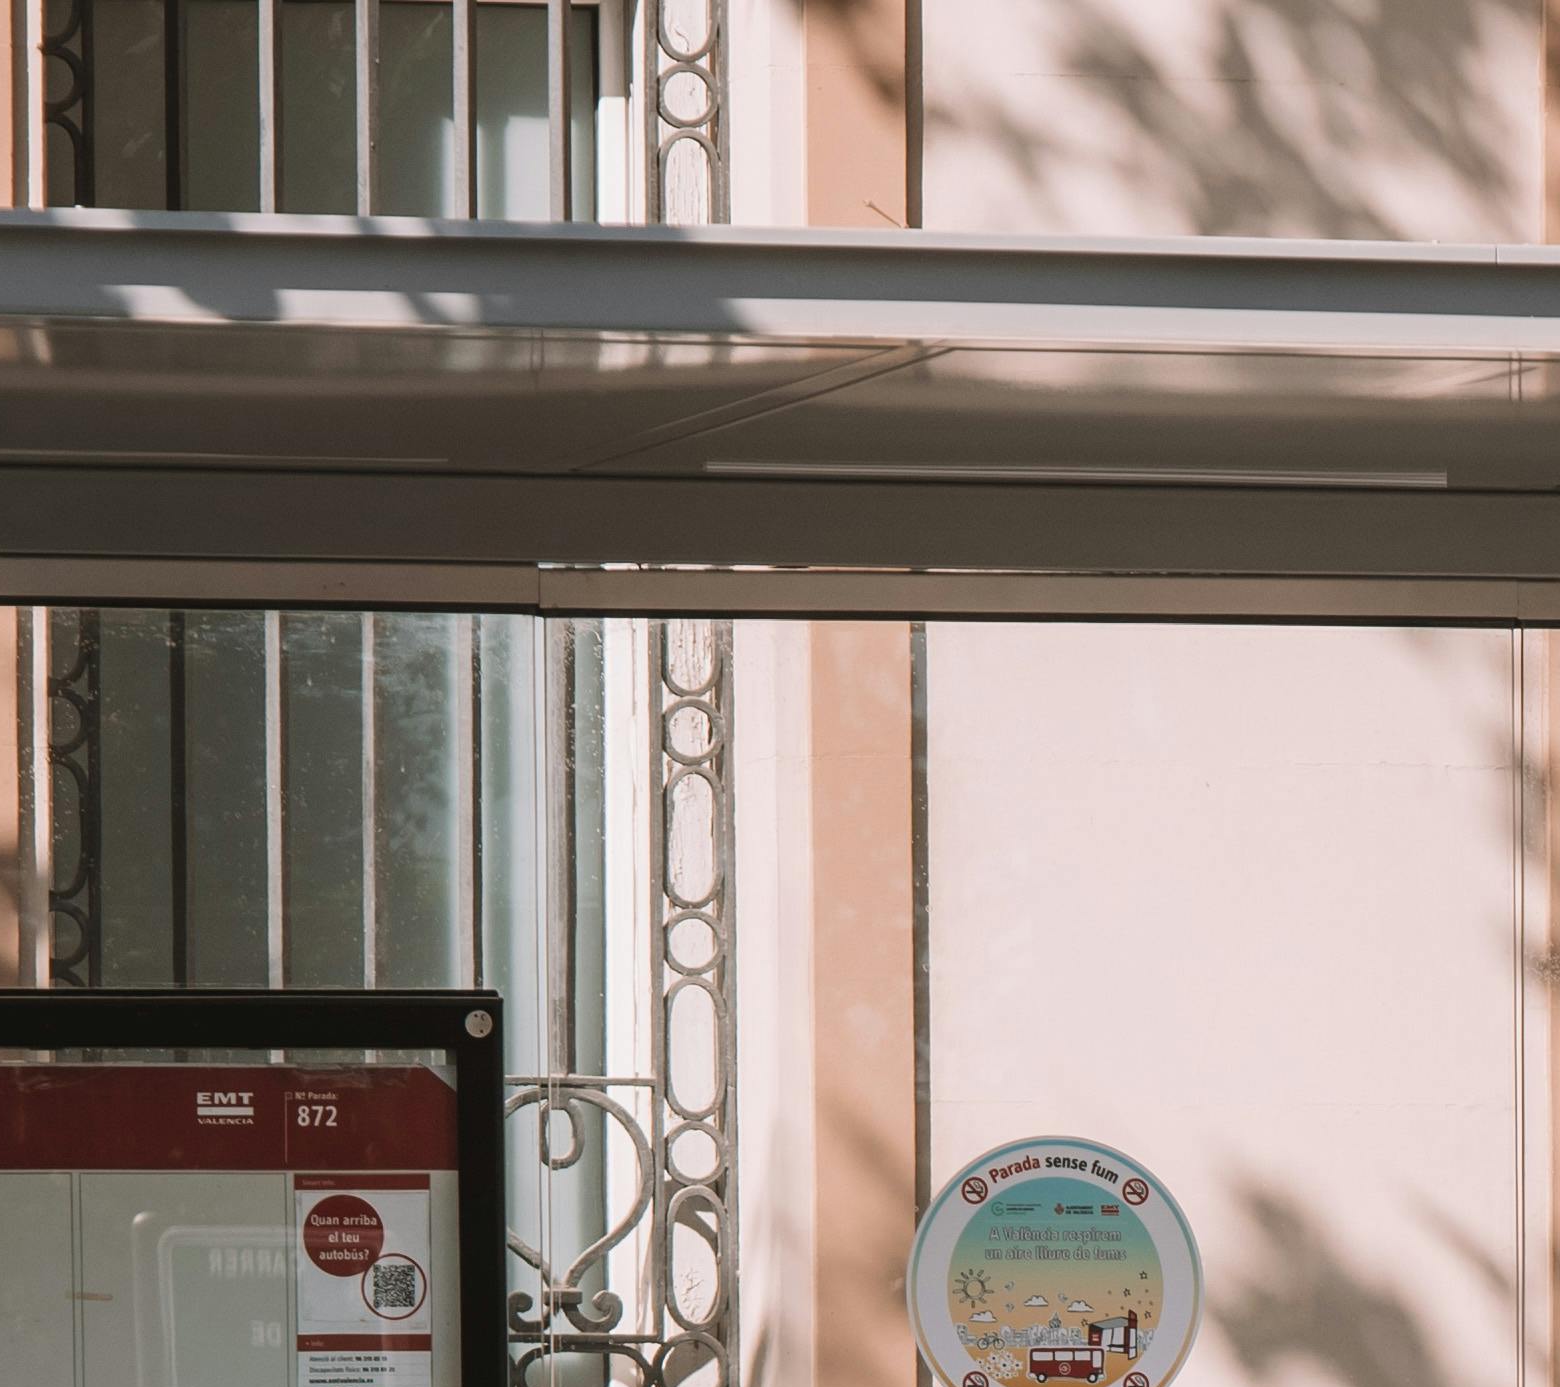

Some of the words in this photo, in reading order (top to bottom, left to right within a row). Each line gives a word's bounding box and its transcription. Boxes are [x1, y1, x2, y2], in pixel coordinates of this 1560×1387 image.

[197, 1092, 254, 1105] EMT
[297, 1105, 338, 1127] 872
[989, 1155, 1040, 1184] Parada
[1045, 1155, 1087, 1171] sense
[1091, 1160, 1120, 1184] fum
[310, 1214, 340, 1227] Quan
[343, 1214, 377, 1227] arriba
[328, 1231, 339, 1243] el
[342, 1232, 360, 1243] teu
[319, 1249, 369, 1260] autobús?
